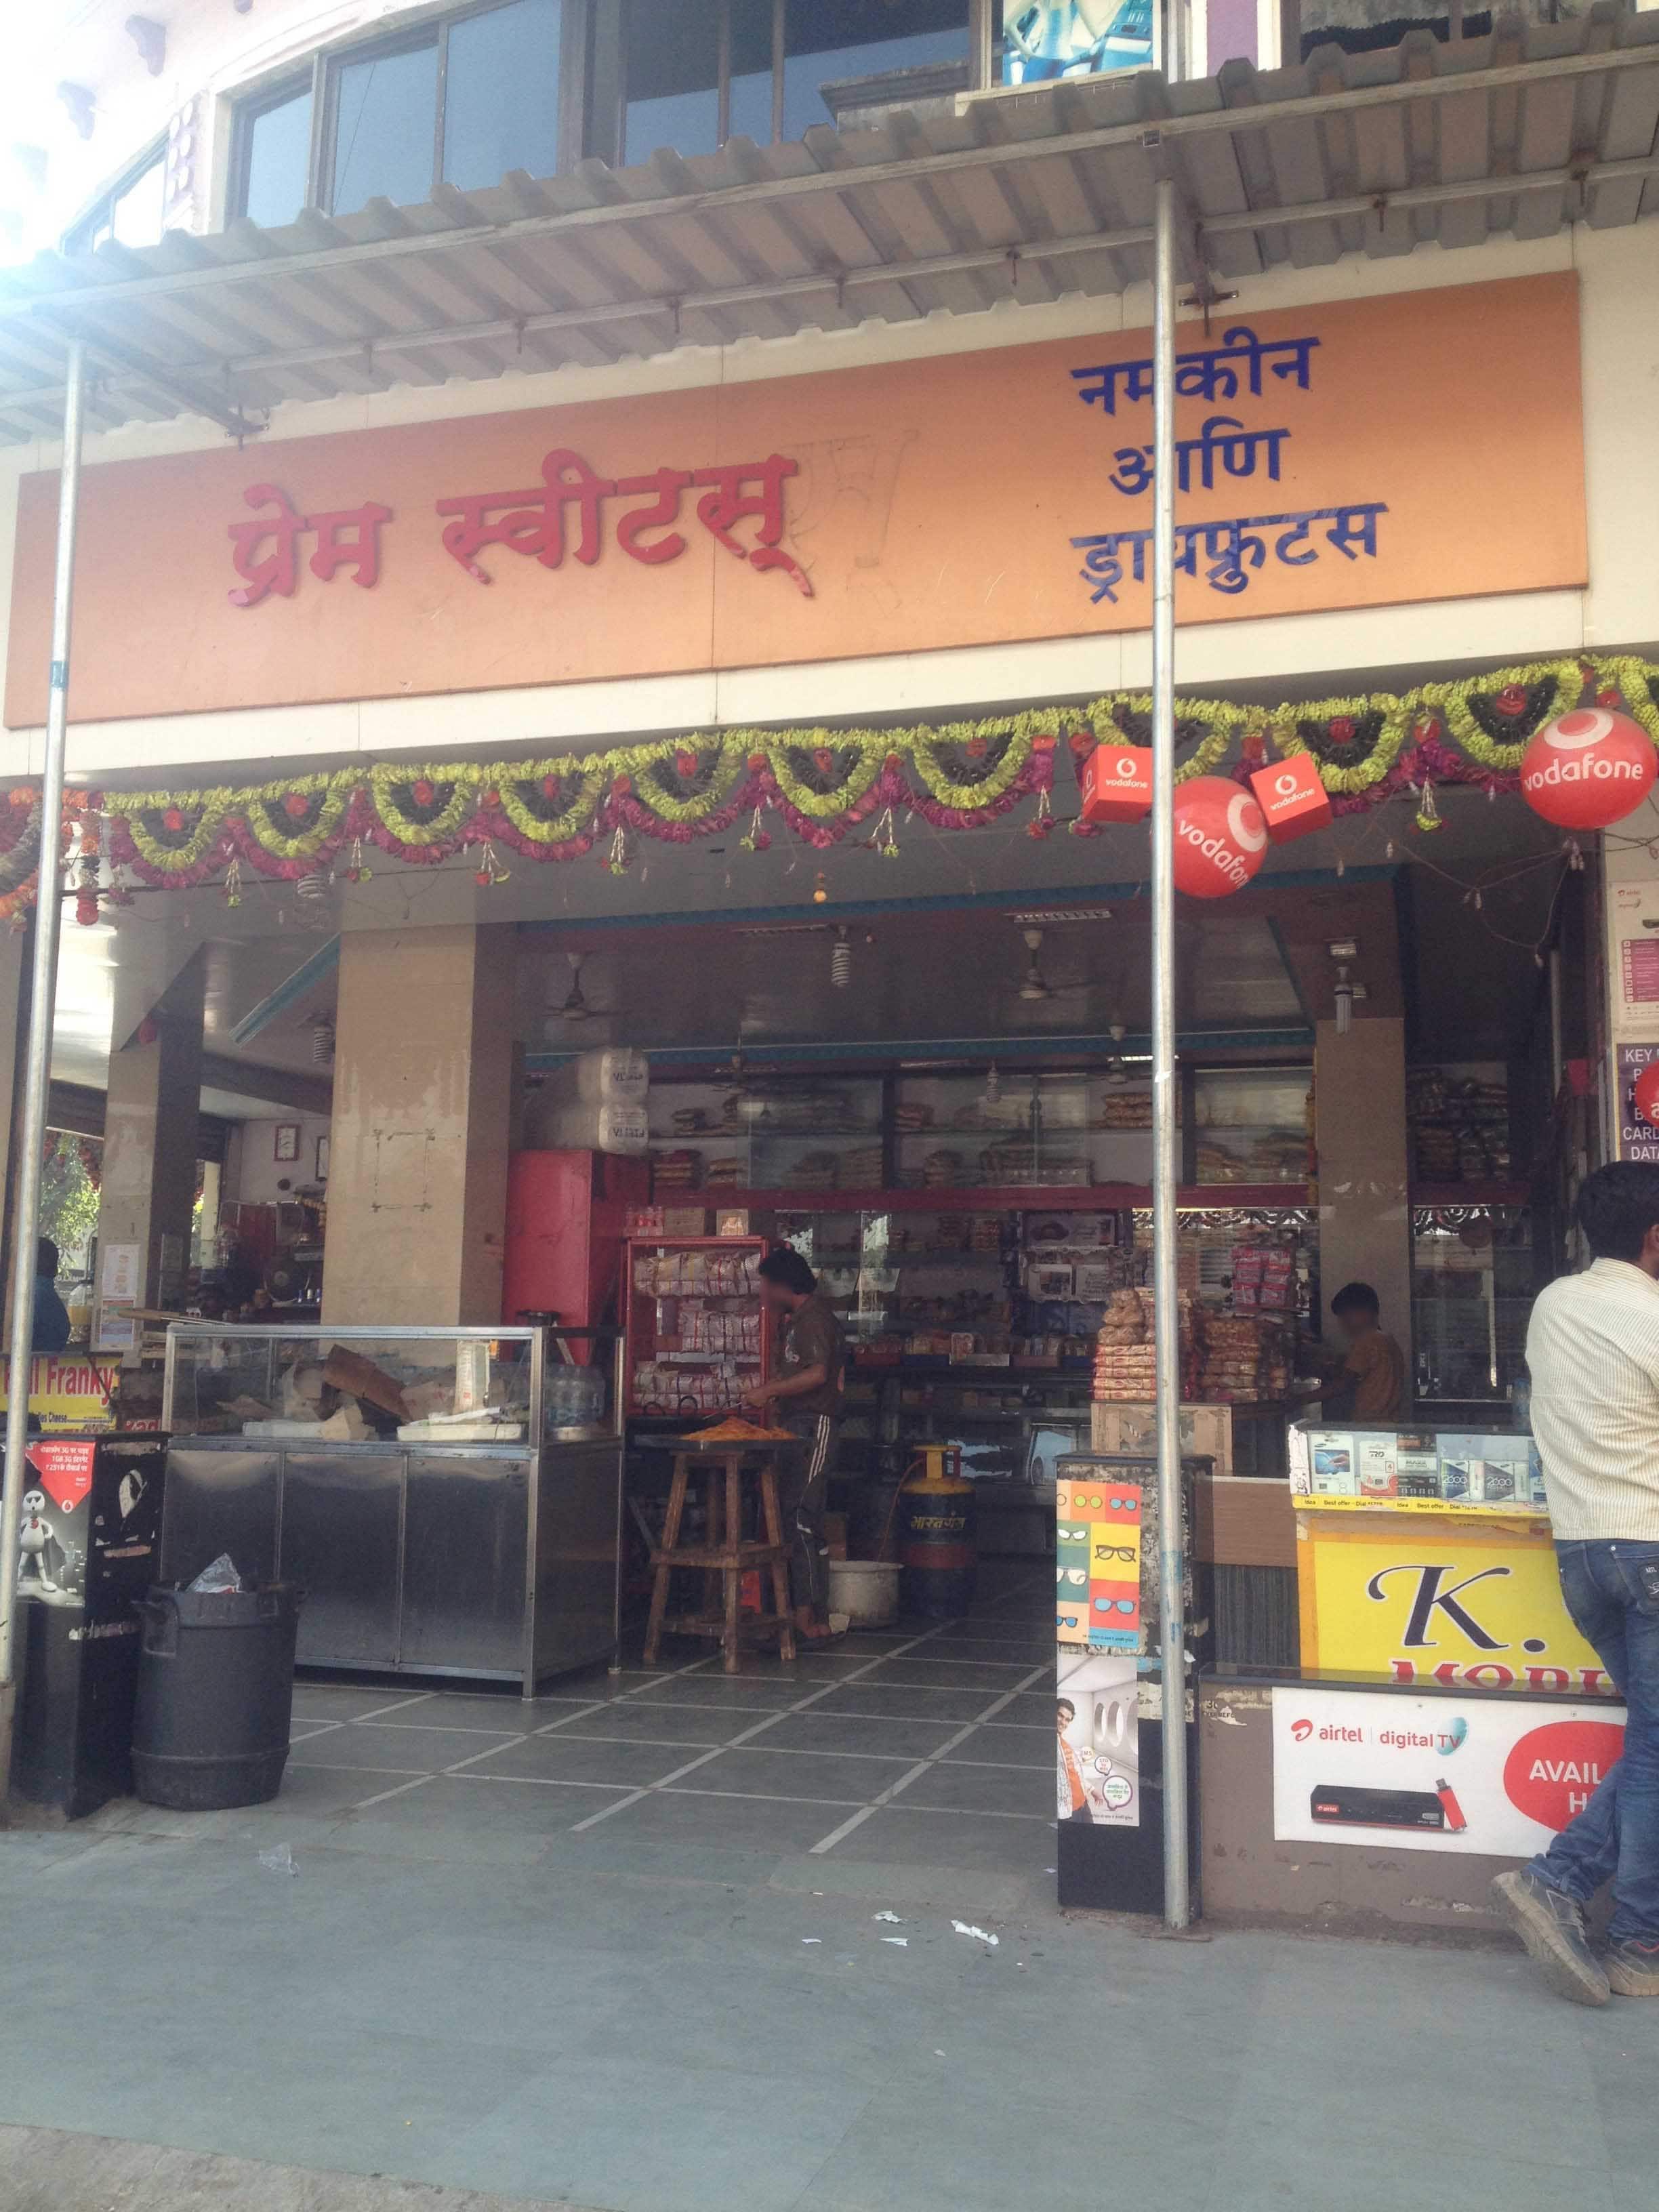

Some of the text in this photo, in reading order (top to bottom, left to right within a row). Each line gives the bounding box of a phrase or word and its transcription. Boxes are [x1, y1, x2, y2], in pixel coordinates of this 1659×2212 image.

[1070, 327, 1322, 416] नमकीन
[1109, 415, 1291, 495] आणि
[227, 483, 393, 607] प्रेम
[1105, 779, 1148, 788] vodafone
[1525, 752, 1643, 792] vodafone
[1270, 787, 1315, 811] vodafone
[1626, 1048, 1652, 1062] KEY
[46, 1355, 115, 1406] Franky
[1368, 1565, 1546, 1652] K.
[1319, 1725, 1461, 1749] airtel digital TV
